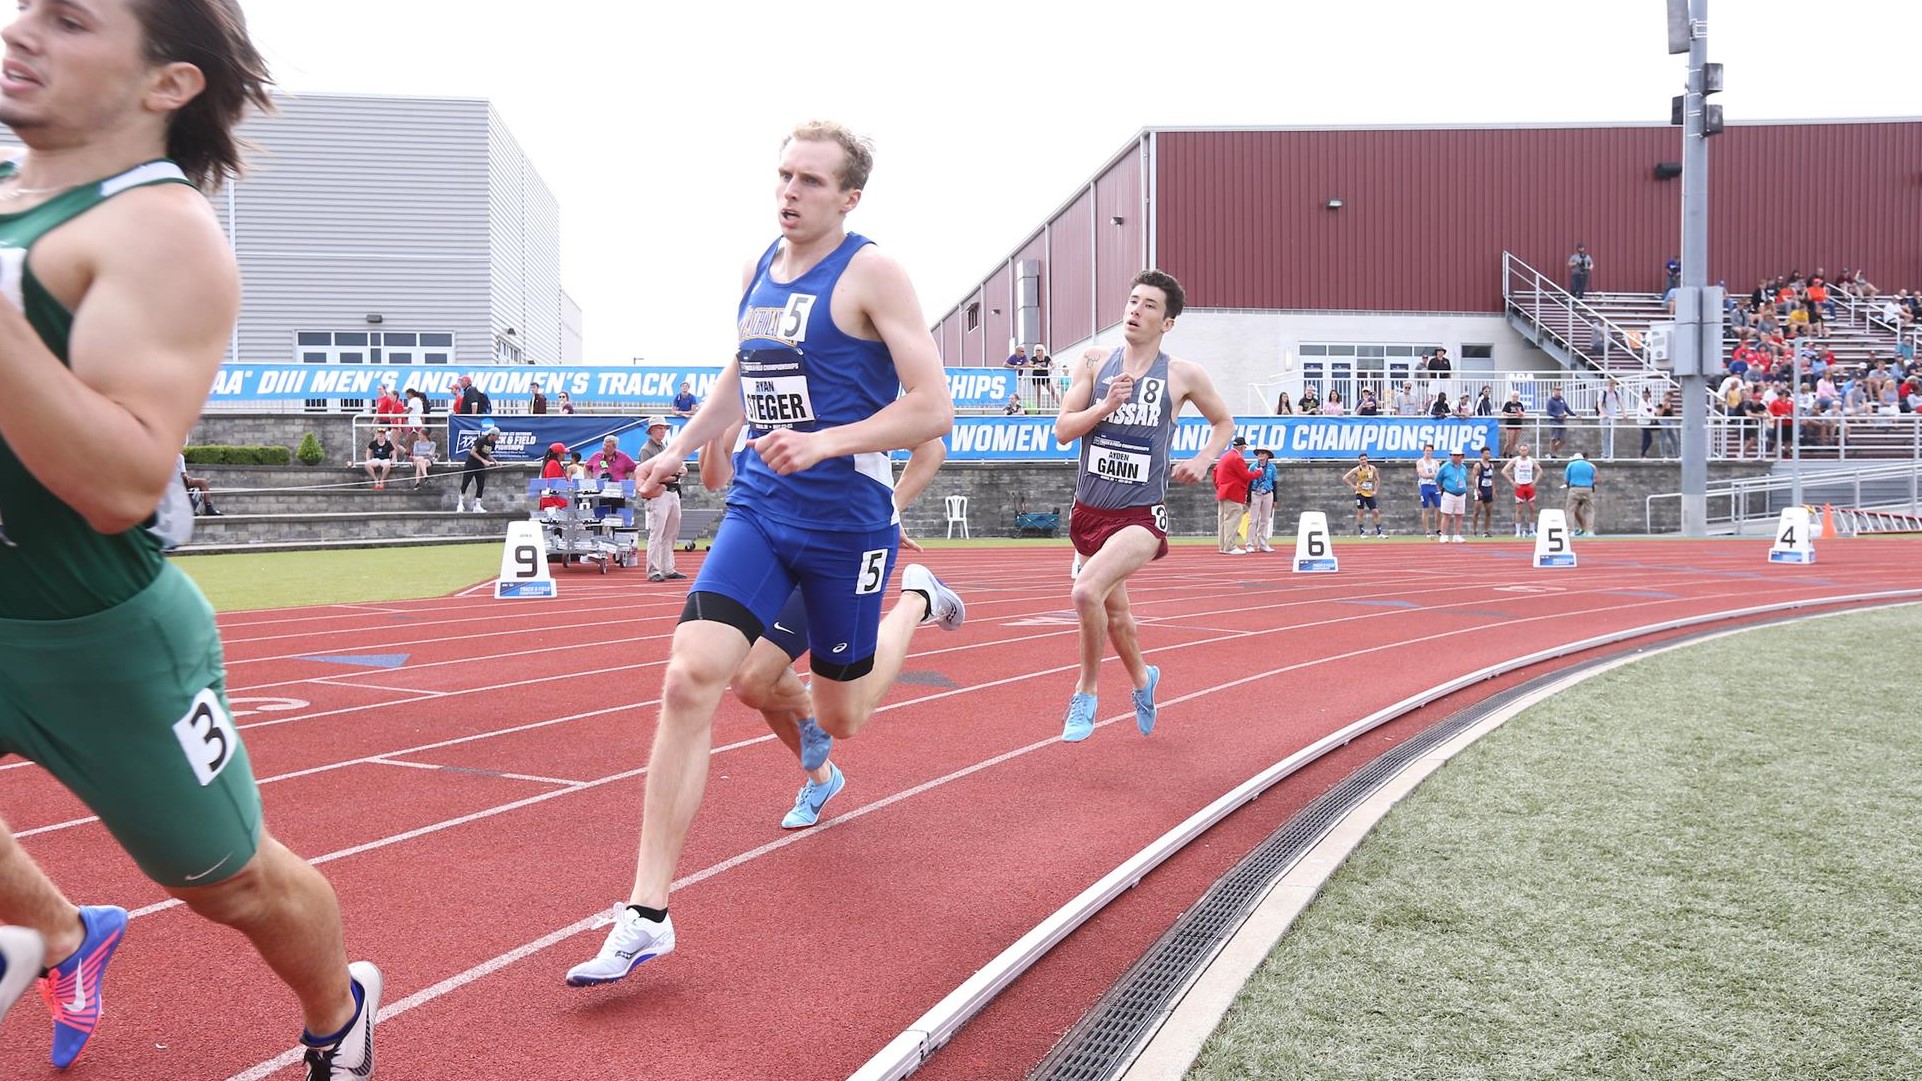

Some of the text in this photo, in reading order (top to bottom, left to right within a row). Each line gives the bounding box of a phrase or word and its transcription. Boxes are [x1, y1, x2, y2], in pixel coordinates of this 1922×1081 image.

[784, 297, 809, 337] 5
[258, 370, 305, 394] DIII
[309, 371, 398, 393] MEN'S
[403, 372, 459, 394] AND
[471, 372, 590, 395] WOMEN'S
[597, 373, 675, 396] TRACK
[679, 373, 721, 398] AN
[755, 380, 775, 393] RYAN
[1143, 379, 1160, 404] 8
[747, 393, 807, 420] STEGER
[1097, 398, 1162, 428] ASSAR
[1291, 424, 1489, 450] CHAMPIONSHIPS
[1097, 457, 1139, 479] GANN
[1109, 451, 1130, 461] AYDEN
[1308, 531, 1325, 556] 6
[1548, 528, 1564, 552] 5
[1780, 525, 1796, 548] 4
[515, 545, 537, 578] 9
[863, 552, 883, 592] 5
[190, 702, 227, 773] 3
